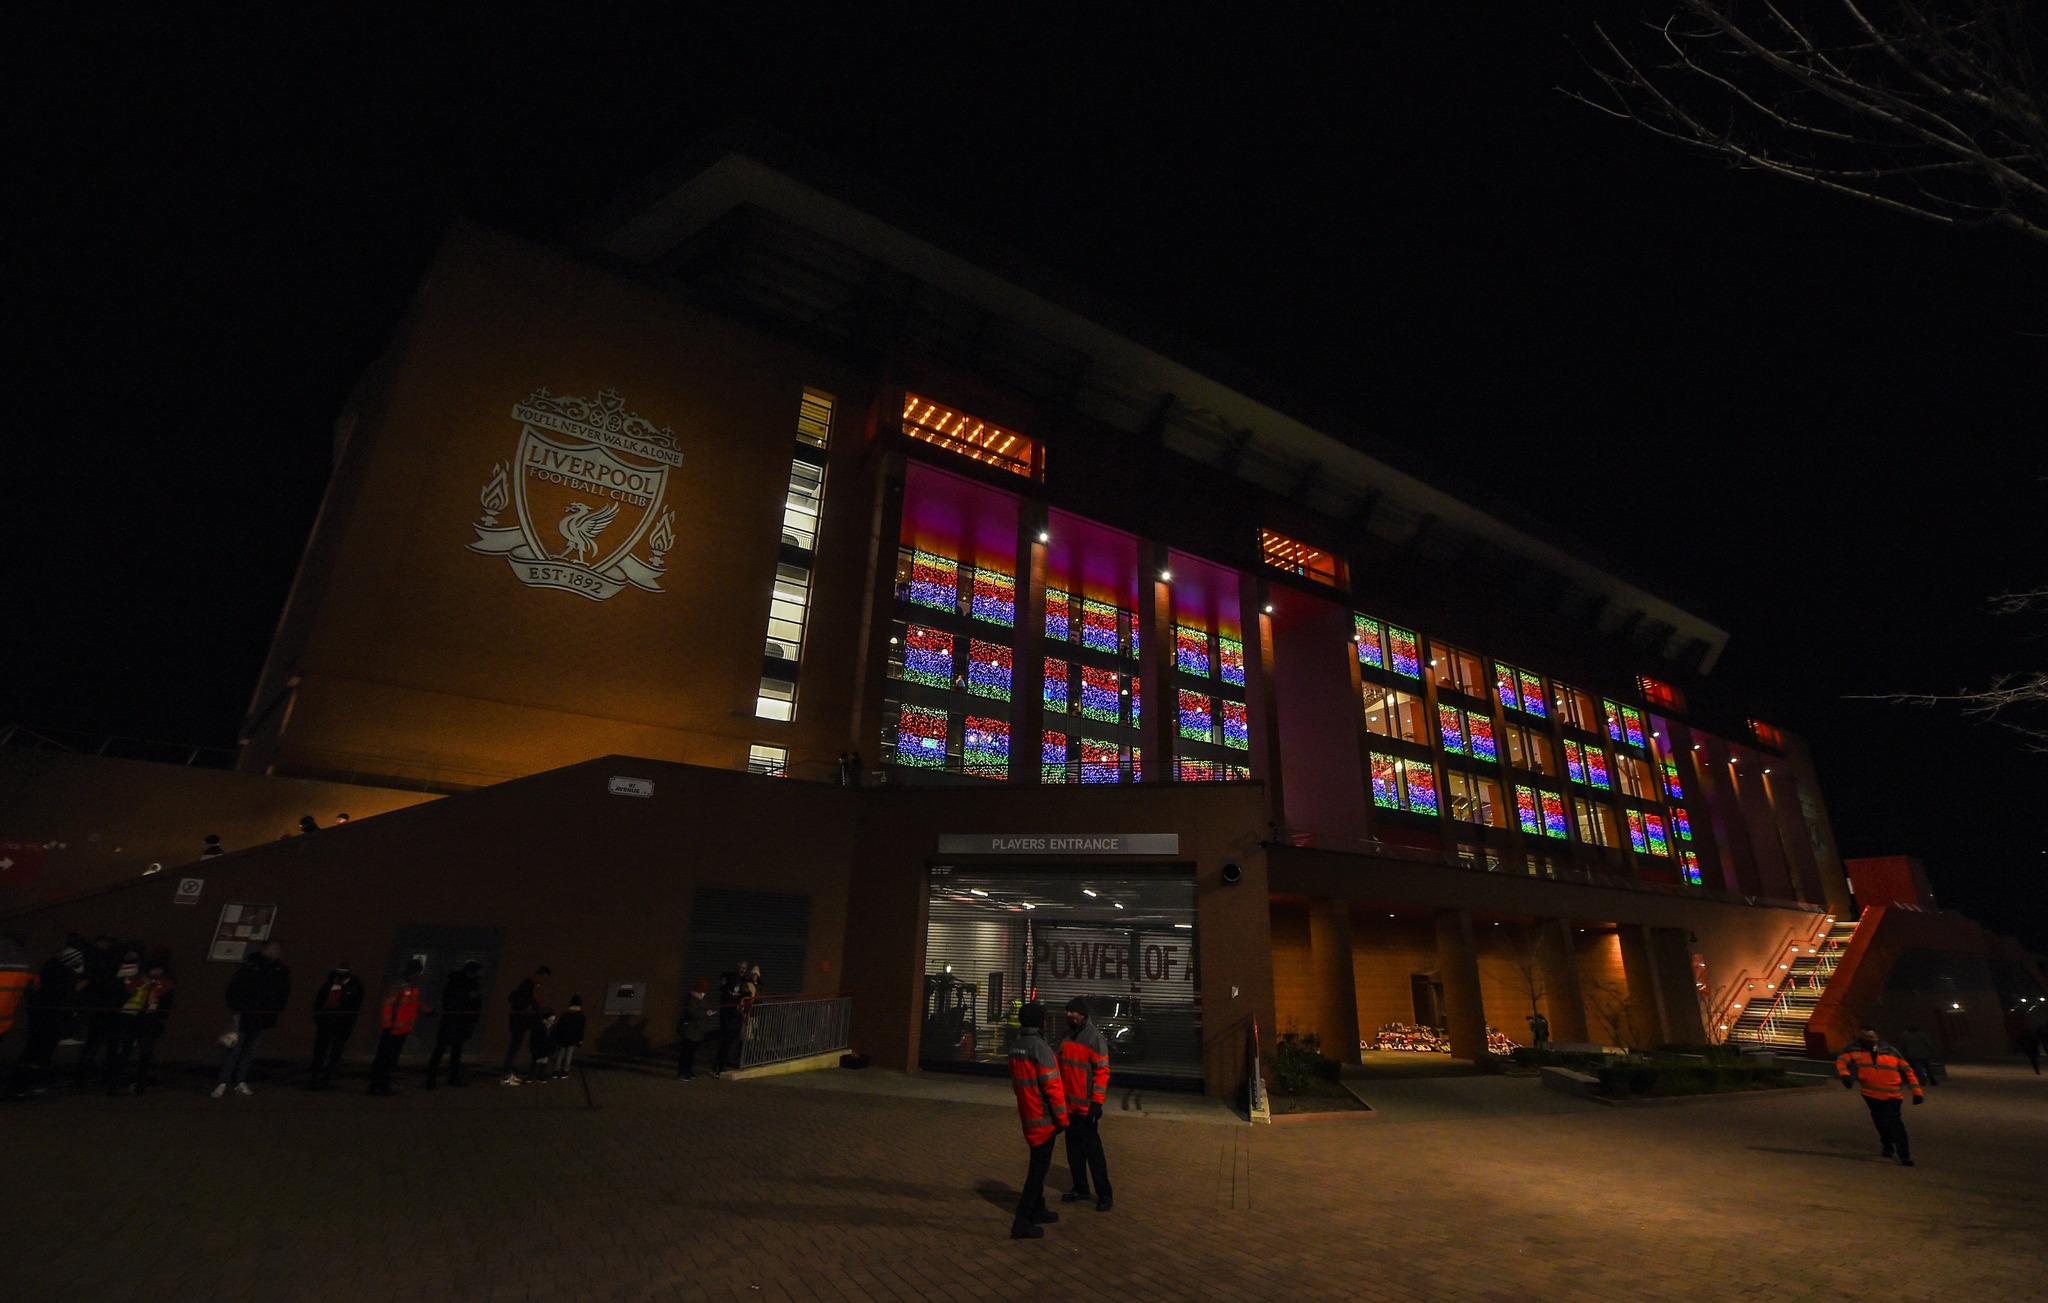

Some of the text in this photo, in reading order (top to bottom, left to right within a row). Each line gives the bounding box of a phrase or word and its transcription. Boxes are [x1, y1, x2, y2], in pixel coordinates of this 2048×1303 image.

[516, 406, 680, 464] YOU'LL NEVER WALK ALONE
[528, 445, 654, 495] LIVERPOOL
[529, 467, 647, 507] FOOTBALL CLUB
[992, 838, 1119, 850] PLAYERS ENTRANCE
[1034, 939, 1133, 980] POWER
[1144, 944, 1178, 981] OF
